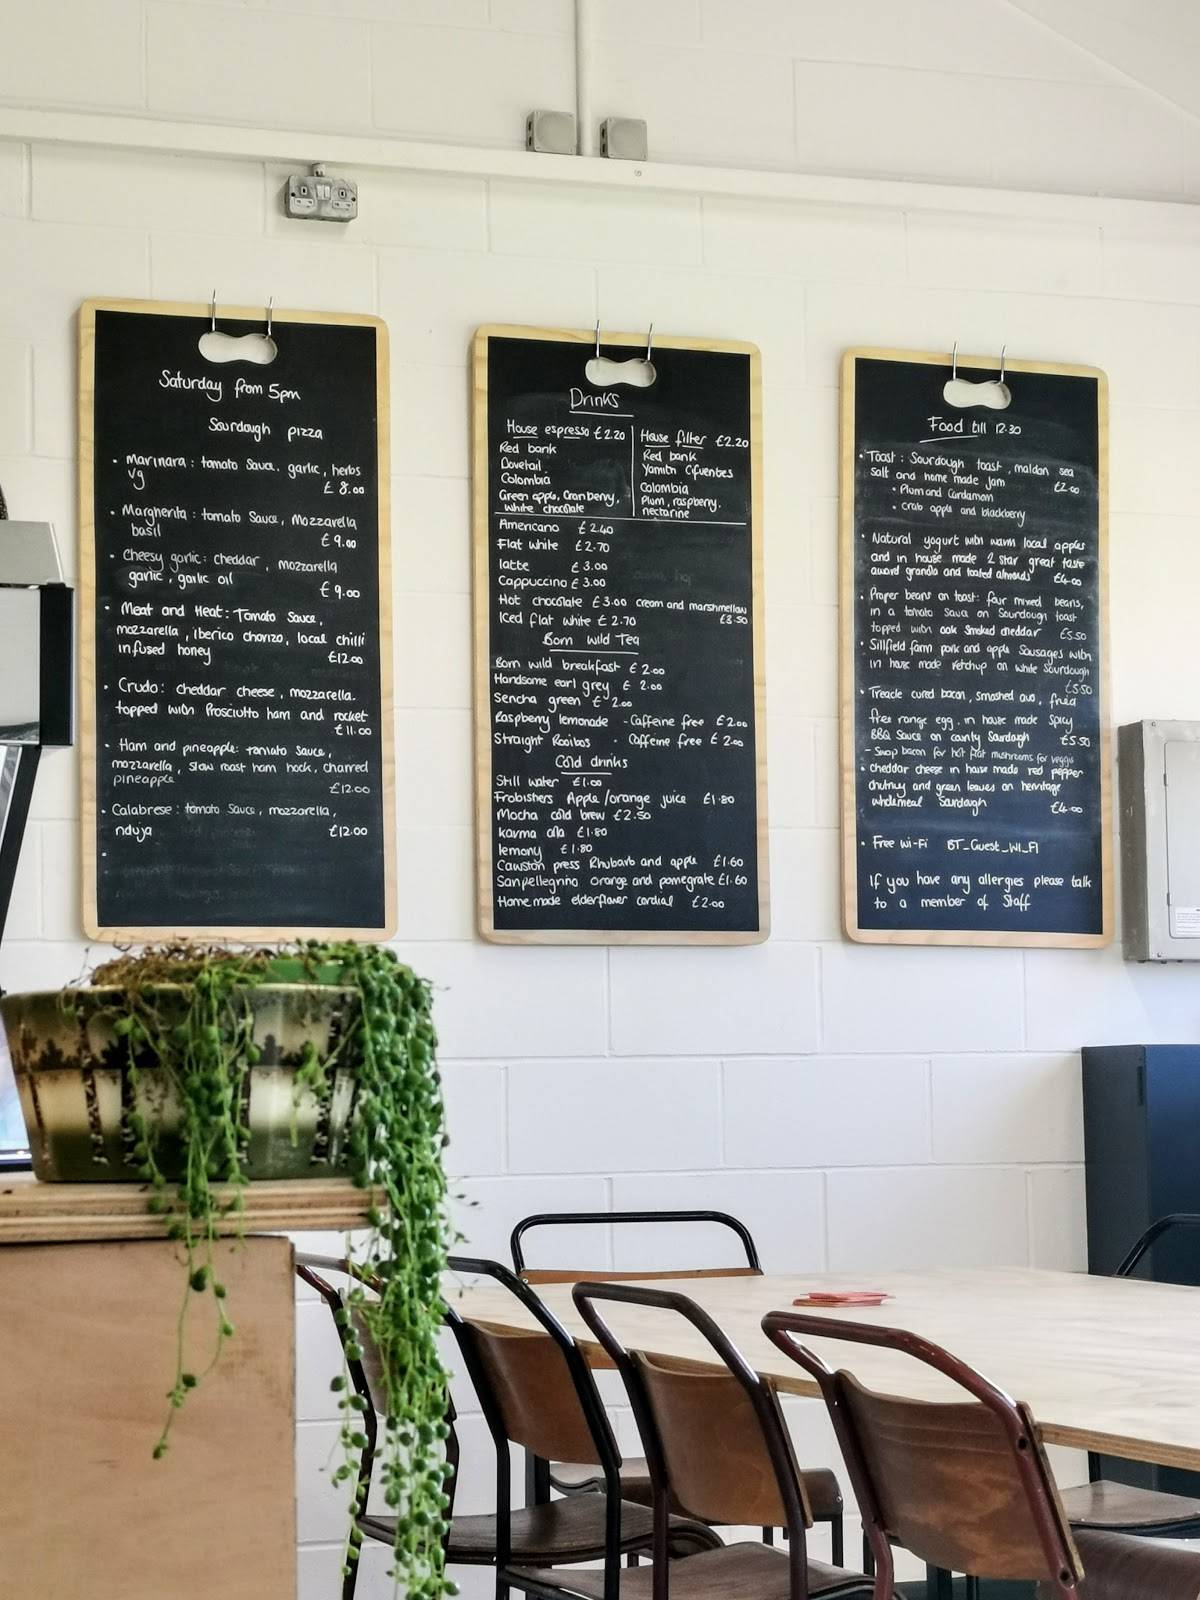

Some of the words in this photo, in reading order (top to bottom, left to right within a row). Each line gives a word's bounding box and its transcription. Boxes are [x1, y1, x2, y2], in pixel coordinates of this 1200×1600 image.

[159, 370, 222, 402] Saturday
[235, 378, 262, 398] from
[268, 384, 300, 403] 5pm
[570, 388, 619, 409] Drinks
[507, 419, 537, 435] House
[545, 426, 589, 438] espresso
[928, 416, 963, 432] Food
[972, 421, 986, 433] till
[288, 427, 322, 442] pizza
[641, 429, 668, 443] House
[675, 430, 706, 447] filter
[500, 441, 519, 453] Red
[528, 443, 556, 454] bank
[201, 456, 238, 470] tomato
[643, 449, 662, 462] Red
[670, 451, 696, 461] bank
[501, 473, 550, 485] Colombia
[896, 472, 916, 480] and
[954, 475, 978, 485] made
[640, 482, 688, 495] Colombia
[201, 508, 241, 523] tomato
[131, 521, 161, 536] basil
[500, 519, 559, 532] Americano
[497, 539, 522, 550] Flat
[529, 539, 558, 550] white
[872, 532, 911, 544] Natural
[924, 535, 959, 552] yogurt
[1024, 537, 1047, 548] local
[1055, 540, 1085, 554] apples
[871, 552, 890, 562] and
[897, 555, 907, 563] in
[915, 551, 942, 563] house
[952, 553, 976, 564] made
[987, 552, 995, 564] 2
[1029, 557, 1055, 574] great
[499, 575, 567, 590] Cappuccino
[499, 594, 520, 605] Hot
[533, 596, 582, 607] chocolate
[667, 600, 684, 610] and
[121, 602, 153, 616] Meat
[162, 605, 185, 616] and
[233, 608, 276, 622] Tomato
[194, 627, 234, 641] iberico
[298, 632, 327, 643] local
[336, 632, 364, 646] chilli
[587, 633, 610, 645] wild
[615, 633, 639, 646] Tea
[119, 640, 165, 657] infused
[178, 644, 211, 665] honey
[528, 657, 552, 669] wild
[562, 659, 620, 675] breakfast
[119, 677, 164, 693] Crudo:
[176, 683, 226, 696] cheddar
[115, 701, 158, 717] topped
[206, 703, 259, 718] Prosciutto
[267, 707, 290, 720] ham
[300, 709, 324, 721] and
[334, 710, 368, 722] rocket
[556, 755, 582, 768] Cold
[591, 753, 627, 768] drinks
[497, 775, 520, 786] Still
[528, 776, 559, 787] water
[497, 809, 538, 820] Mocha
[551, 808, 572, 820] cold
[580, 809, 605, 820] brew
[116, 824, 152, 842] nduja
[873, 835, 895, 849] Free
[641, 856, 661, 866] and
[632, 874, 652, 886] and
[870, 873, 882, 889] If
[887, 878, 909, 894] you
[917, 871, 940, 884] have
[951, 875, 970, 894] any
[978, 873, 1024, 893] allergies
[1034, 875, 1064, 888] please
[1071, 875, 1091, 887] talk
[874, 897, 887, 909] to
[900, 899, 906, 908] a
[921, 895, 965, 907] member
[977, 894, 988, 910] of
